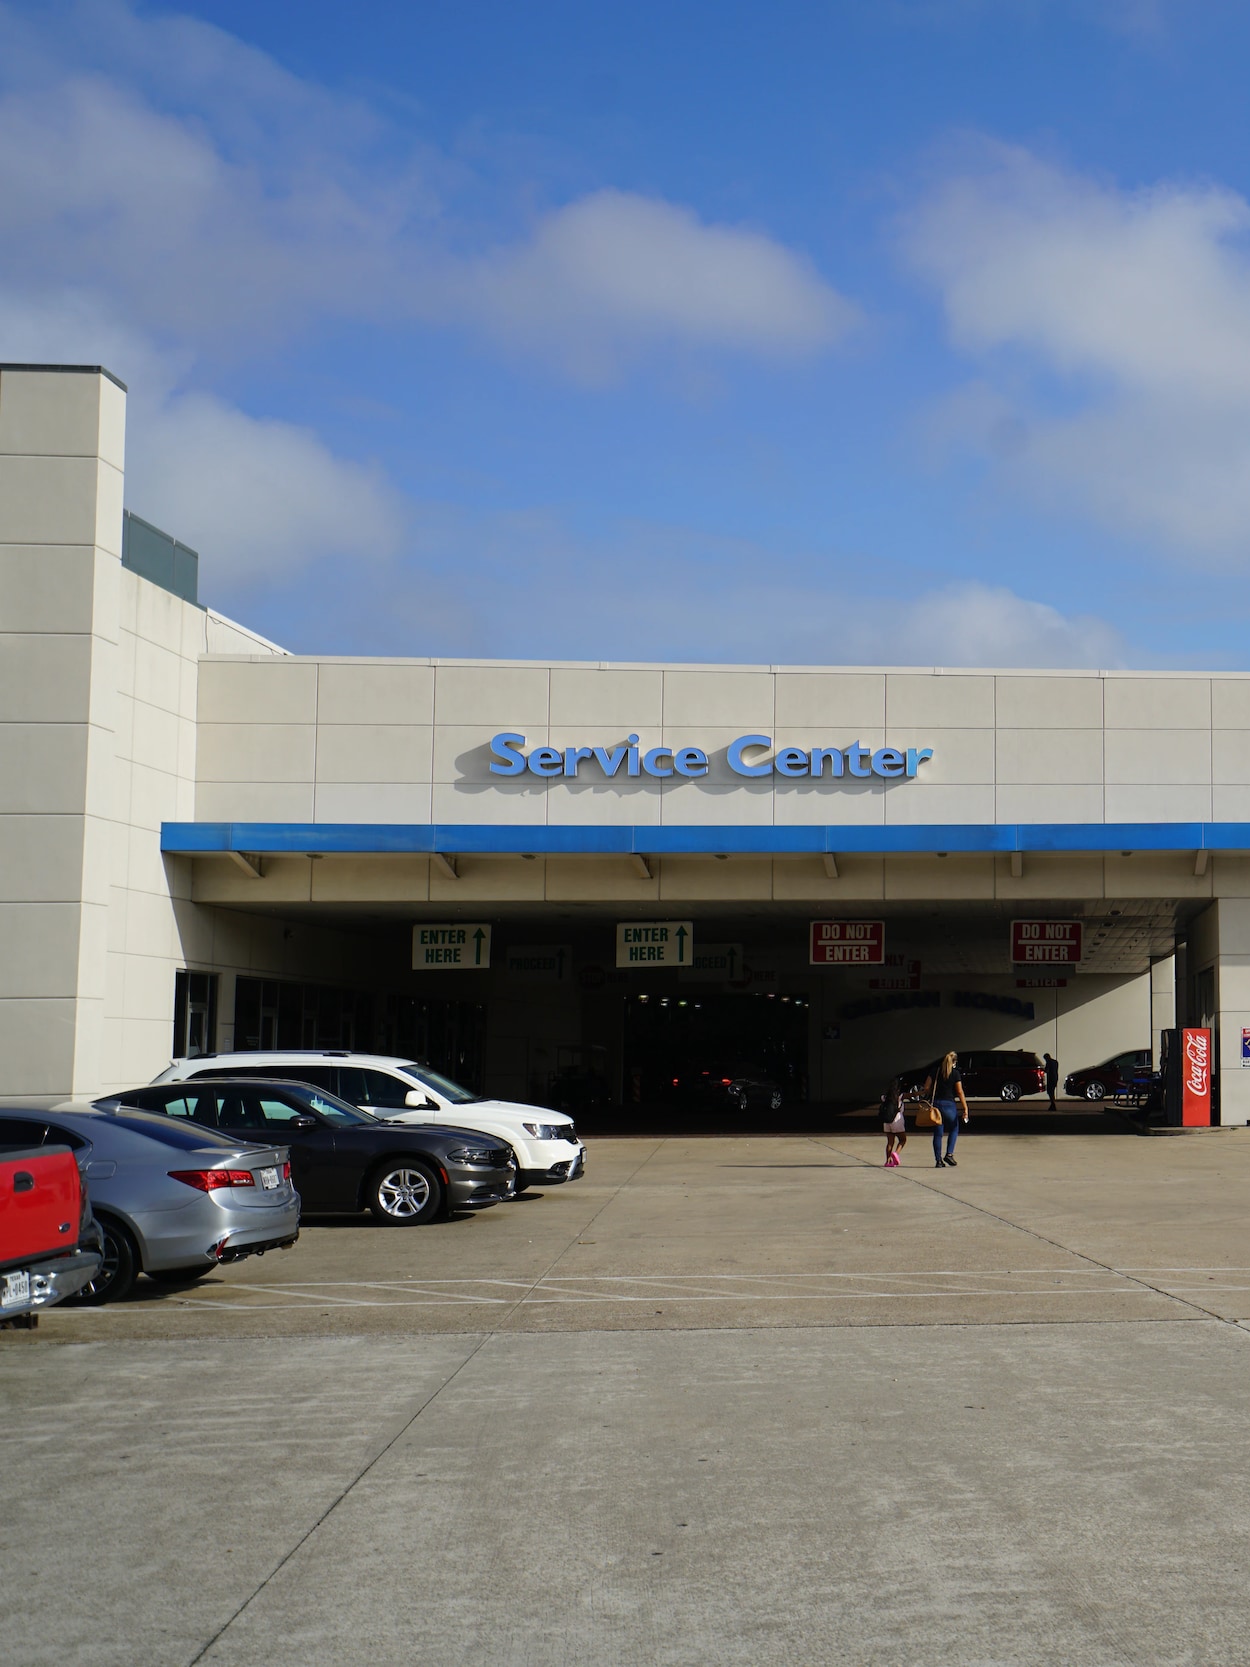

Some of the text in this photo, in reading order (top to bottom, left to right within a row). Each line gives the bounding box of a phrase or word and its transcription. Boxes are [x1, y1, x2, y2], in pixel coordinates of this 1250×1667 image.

[489, 732, 934, 778] Service Center
[420, 930, 466, 944] ENTER
[624, 928, 669, 942] ENTER
[822, 925, 873, 939] DO NOT
[1022, 925, 1072, 938] DO NOT
[425, 949, 461, 963] HERE
[629, 947, 665, 961] HERE
[826, 946, 870, 960] ENTER
[1025, 946, 1069, 960] ENTER
[693, 956, 726, 969] OCEED
